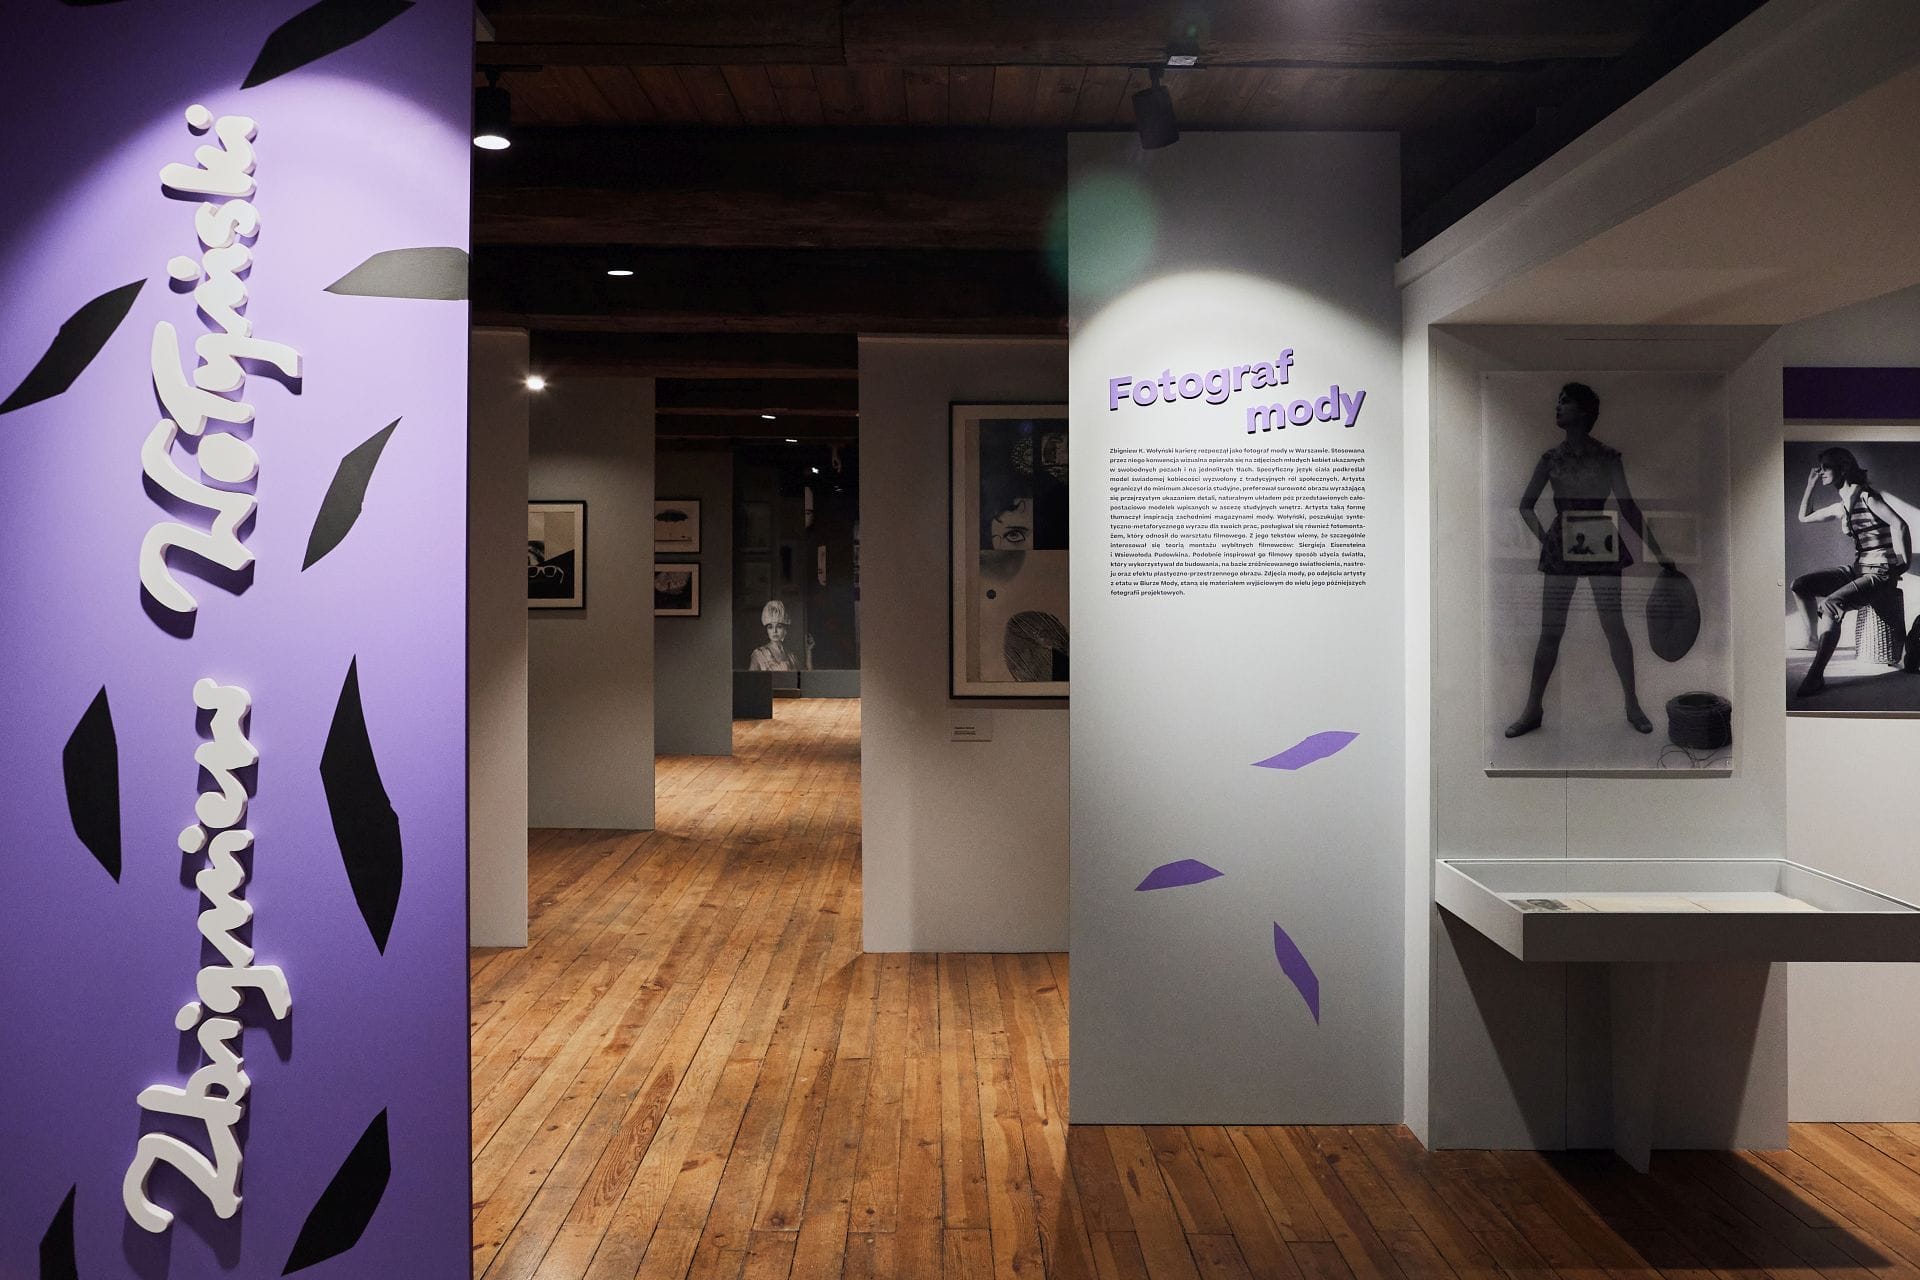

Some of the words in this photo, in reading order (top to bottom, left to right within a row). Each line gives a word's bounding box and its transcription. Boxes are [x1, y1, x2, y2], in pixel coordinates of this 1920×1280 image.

[1110, 348, 1293, 411] Fotograf
[1247, 385, 1366, 434] mody
[123, 678, 292, 1233] Zbigniew
